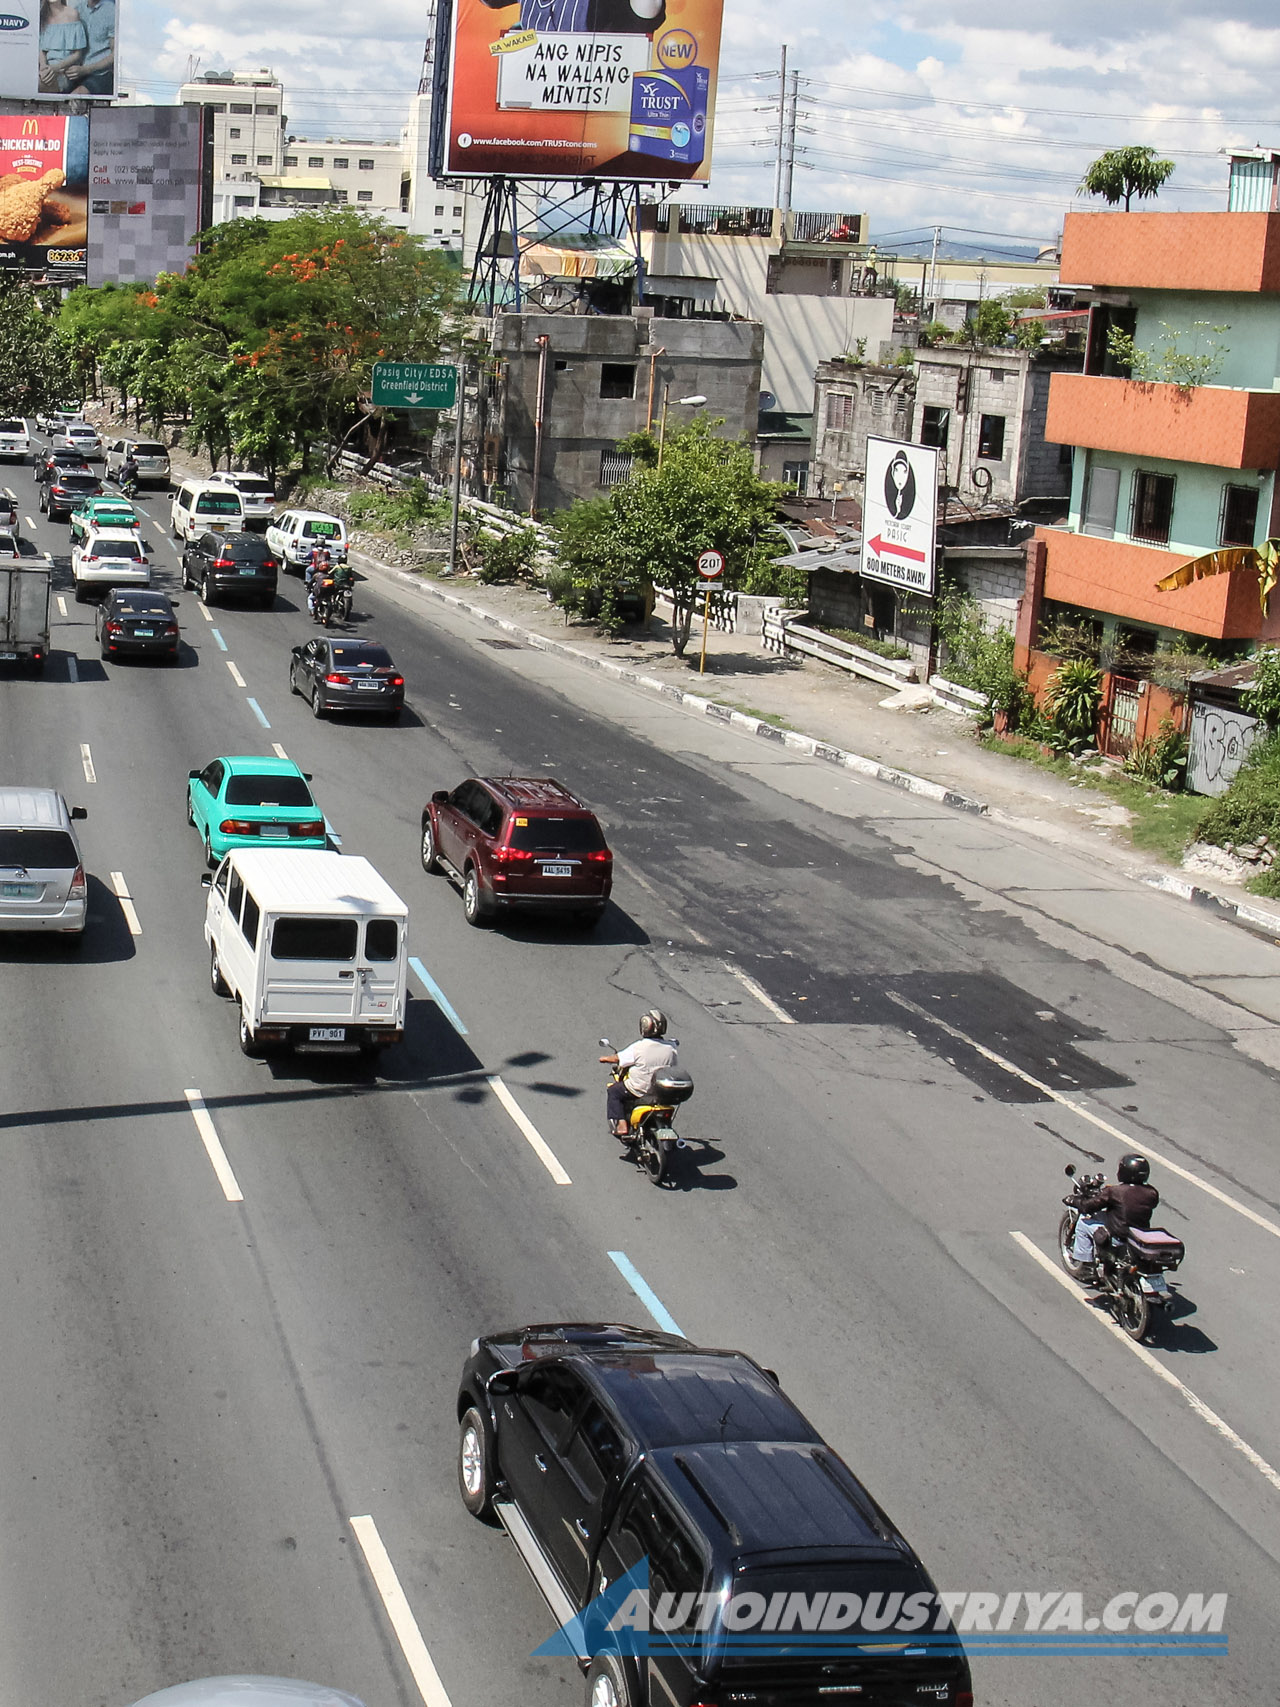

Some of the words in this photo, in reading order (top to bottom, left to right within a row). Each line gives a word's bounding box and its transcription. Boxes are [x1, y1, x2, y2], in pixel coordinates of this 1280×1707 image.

[3, 18, 24, 27] NAVY
[491, 44, 502, 53] SA
[503, 33, 535, 48] WAKAS!
[534, 43, 569, 61] ANG
[575, 43, 623, 63] NIPIS
[661, 43, 693, 59] NEW
[525, 63, 547, 83] NA
[557, 64, 631, 84] WALANG
[542, 85, 610, 105] MINTIS!
[640, 96, 681, 110] TRUST
[93, 165, 108, 173] Call
[93, 176, 111, 185] Click
[376, 366, 400, 379] Pasig
[381, 380, 419, 391] Greenfield
[420, 381, 448, 392] District
[867, 557, 879, 572] 800
[880, 560, 906, 581] METERS
[906, 568, 927, 586] AWAY
